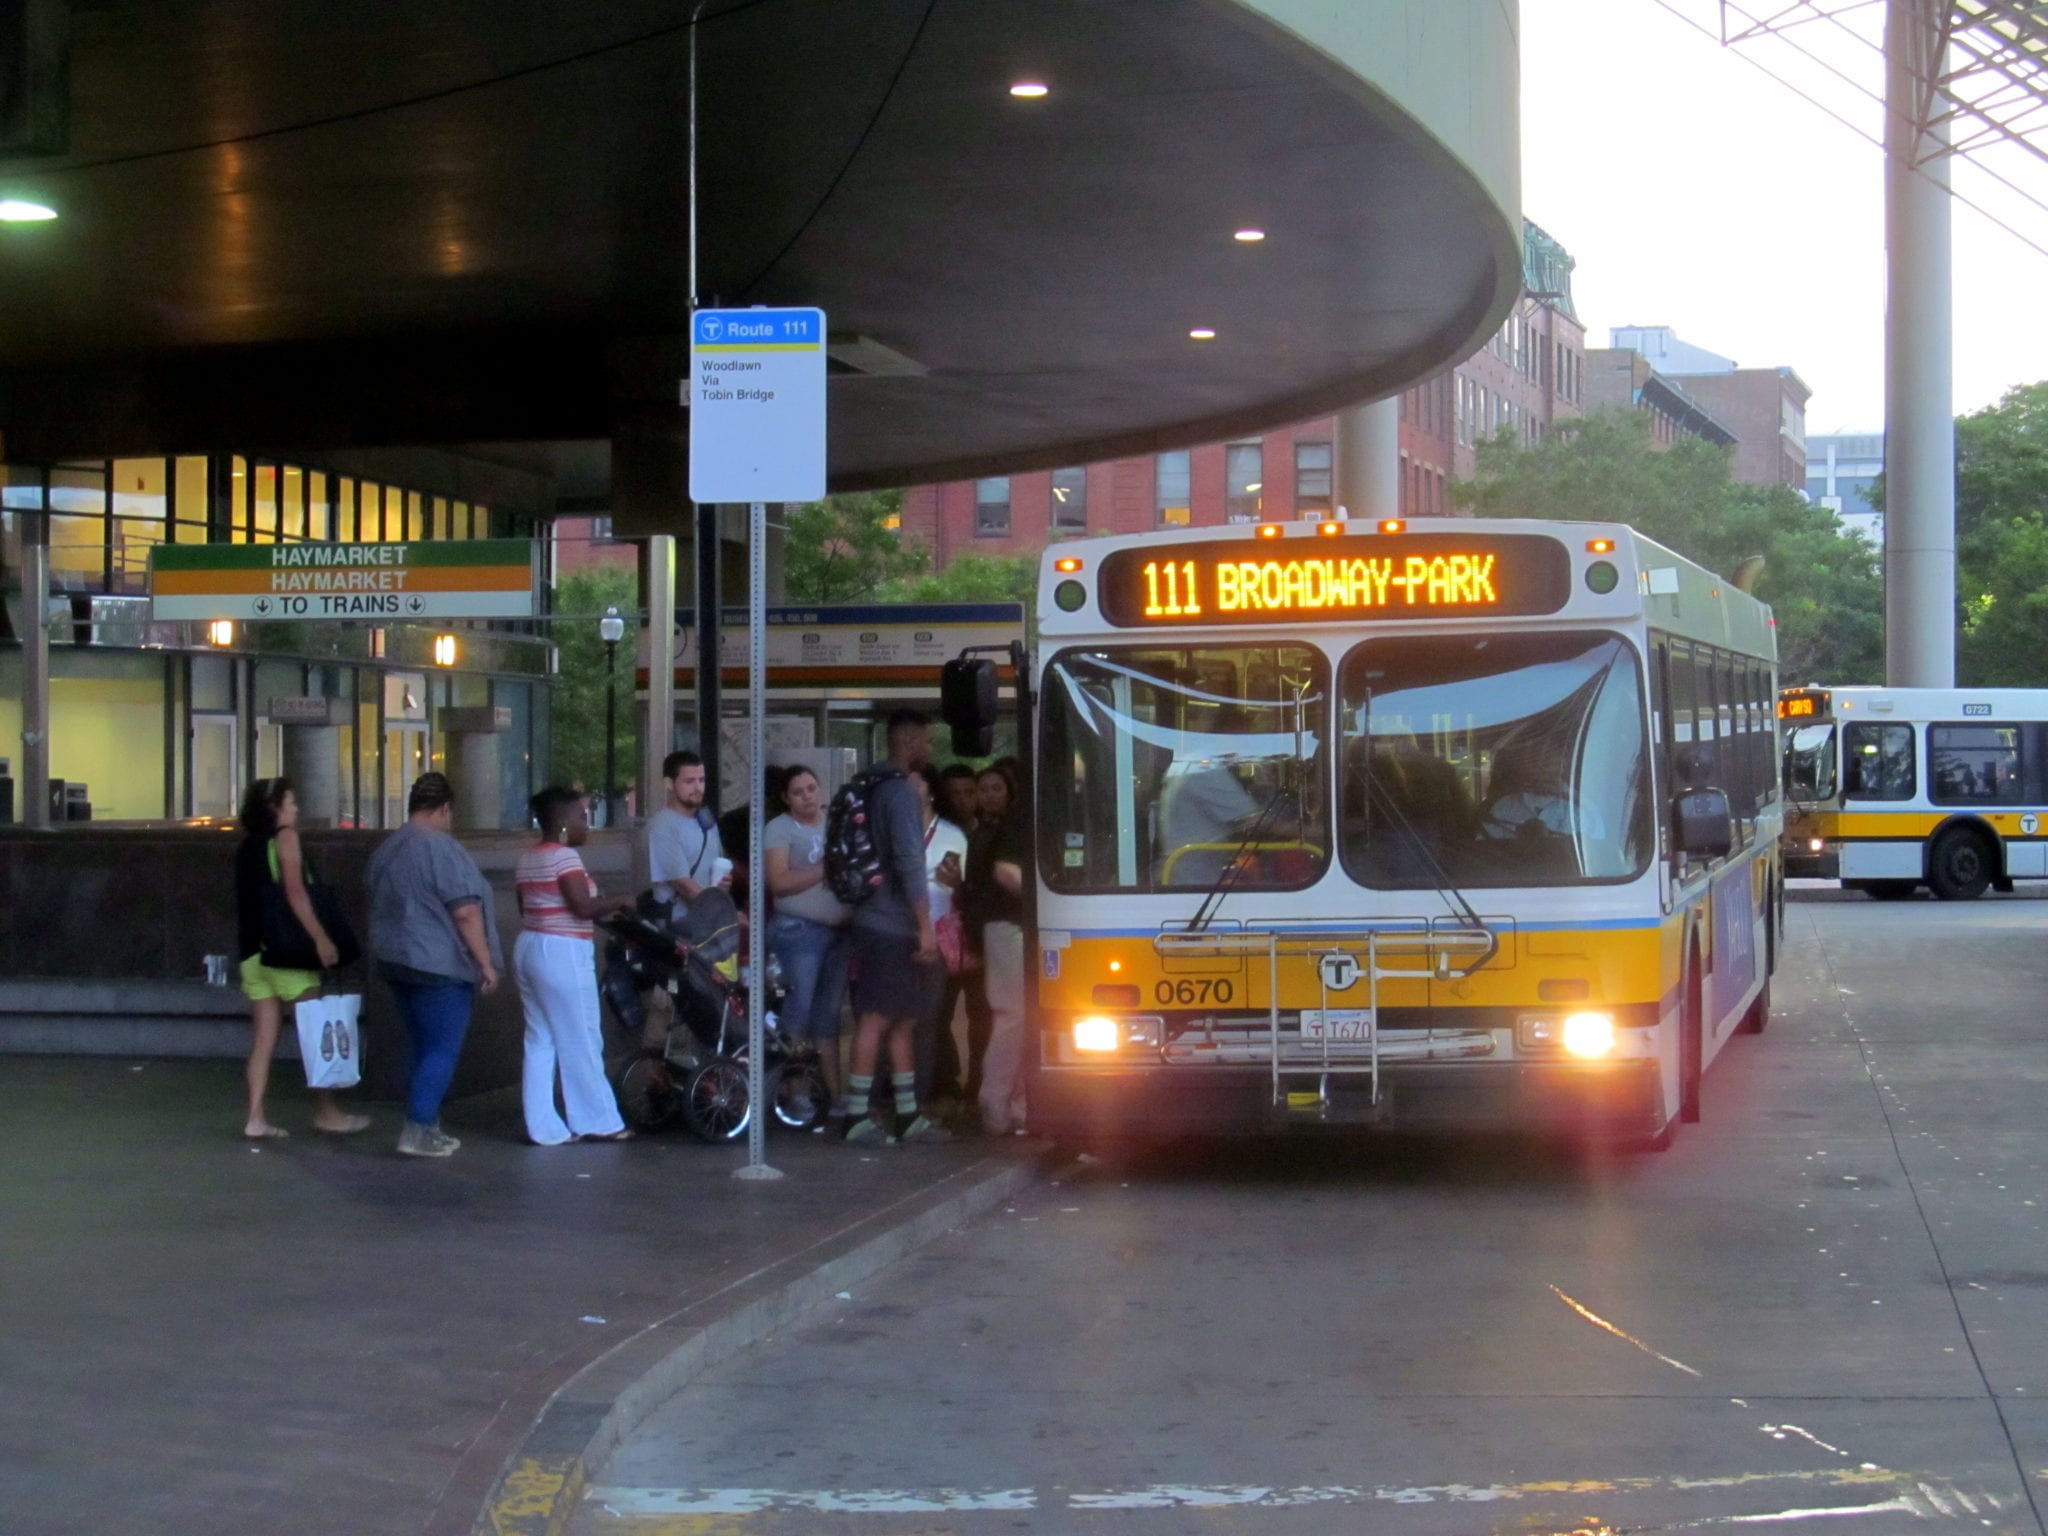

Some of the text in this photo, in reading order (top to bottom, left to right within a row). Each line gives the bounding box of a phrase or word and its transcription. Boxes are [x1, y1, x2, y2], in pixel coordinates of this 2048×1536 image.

[727, 322, 774, 337] Route
[783, 320, 808, 335] 111
[702, 360, 762, 371] Woodlawn
[702, 375, 720, 386] Via
[702, 388, 775, 402] Tobin Bridge
[272, 546, 408, 567] HAYMARKET
[272, 570, 407, 591] HAYMARKET
[1144, 553, 1497, 616] 111 BROADWAY-PARK
[279, 595, 400, 615] TO TRAINS
[1965, 704, 1990, 715] 0722
[1154, 978, 1234, 1005] 0670
[1329, 1020, 1372, 1040] T670
